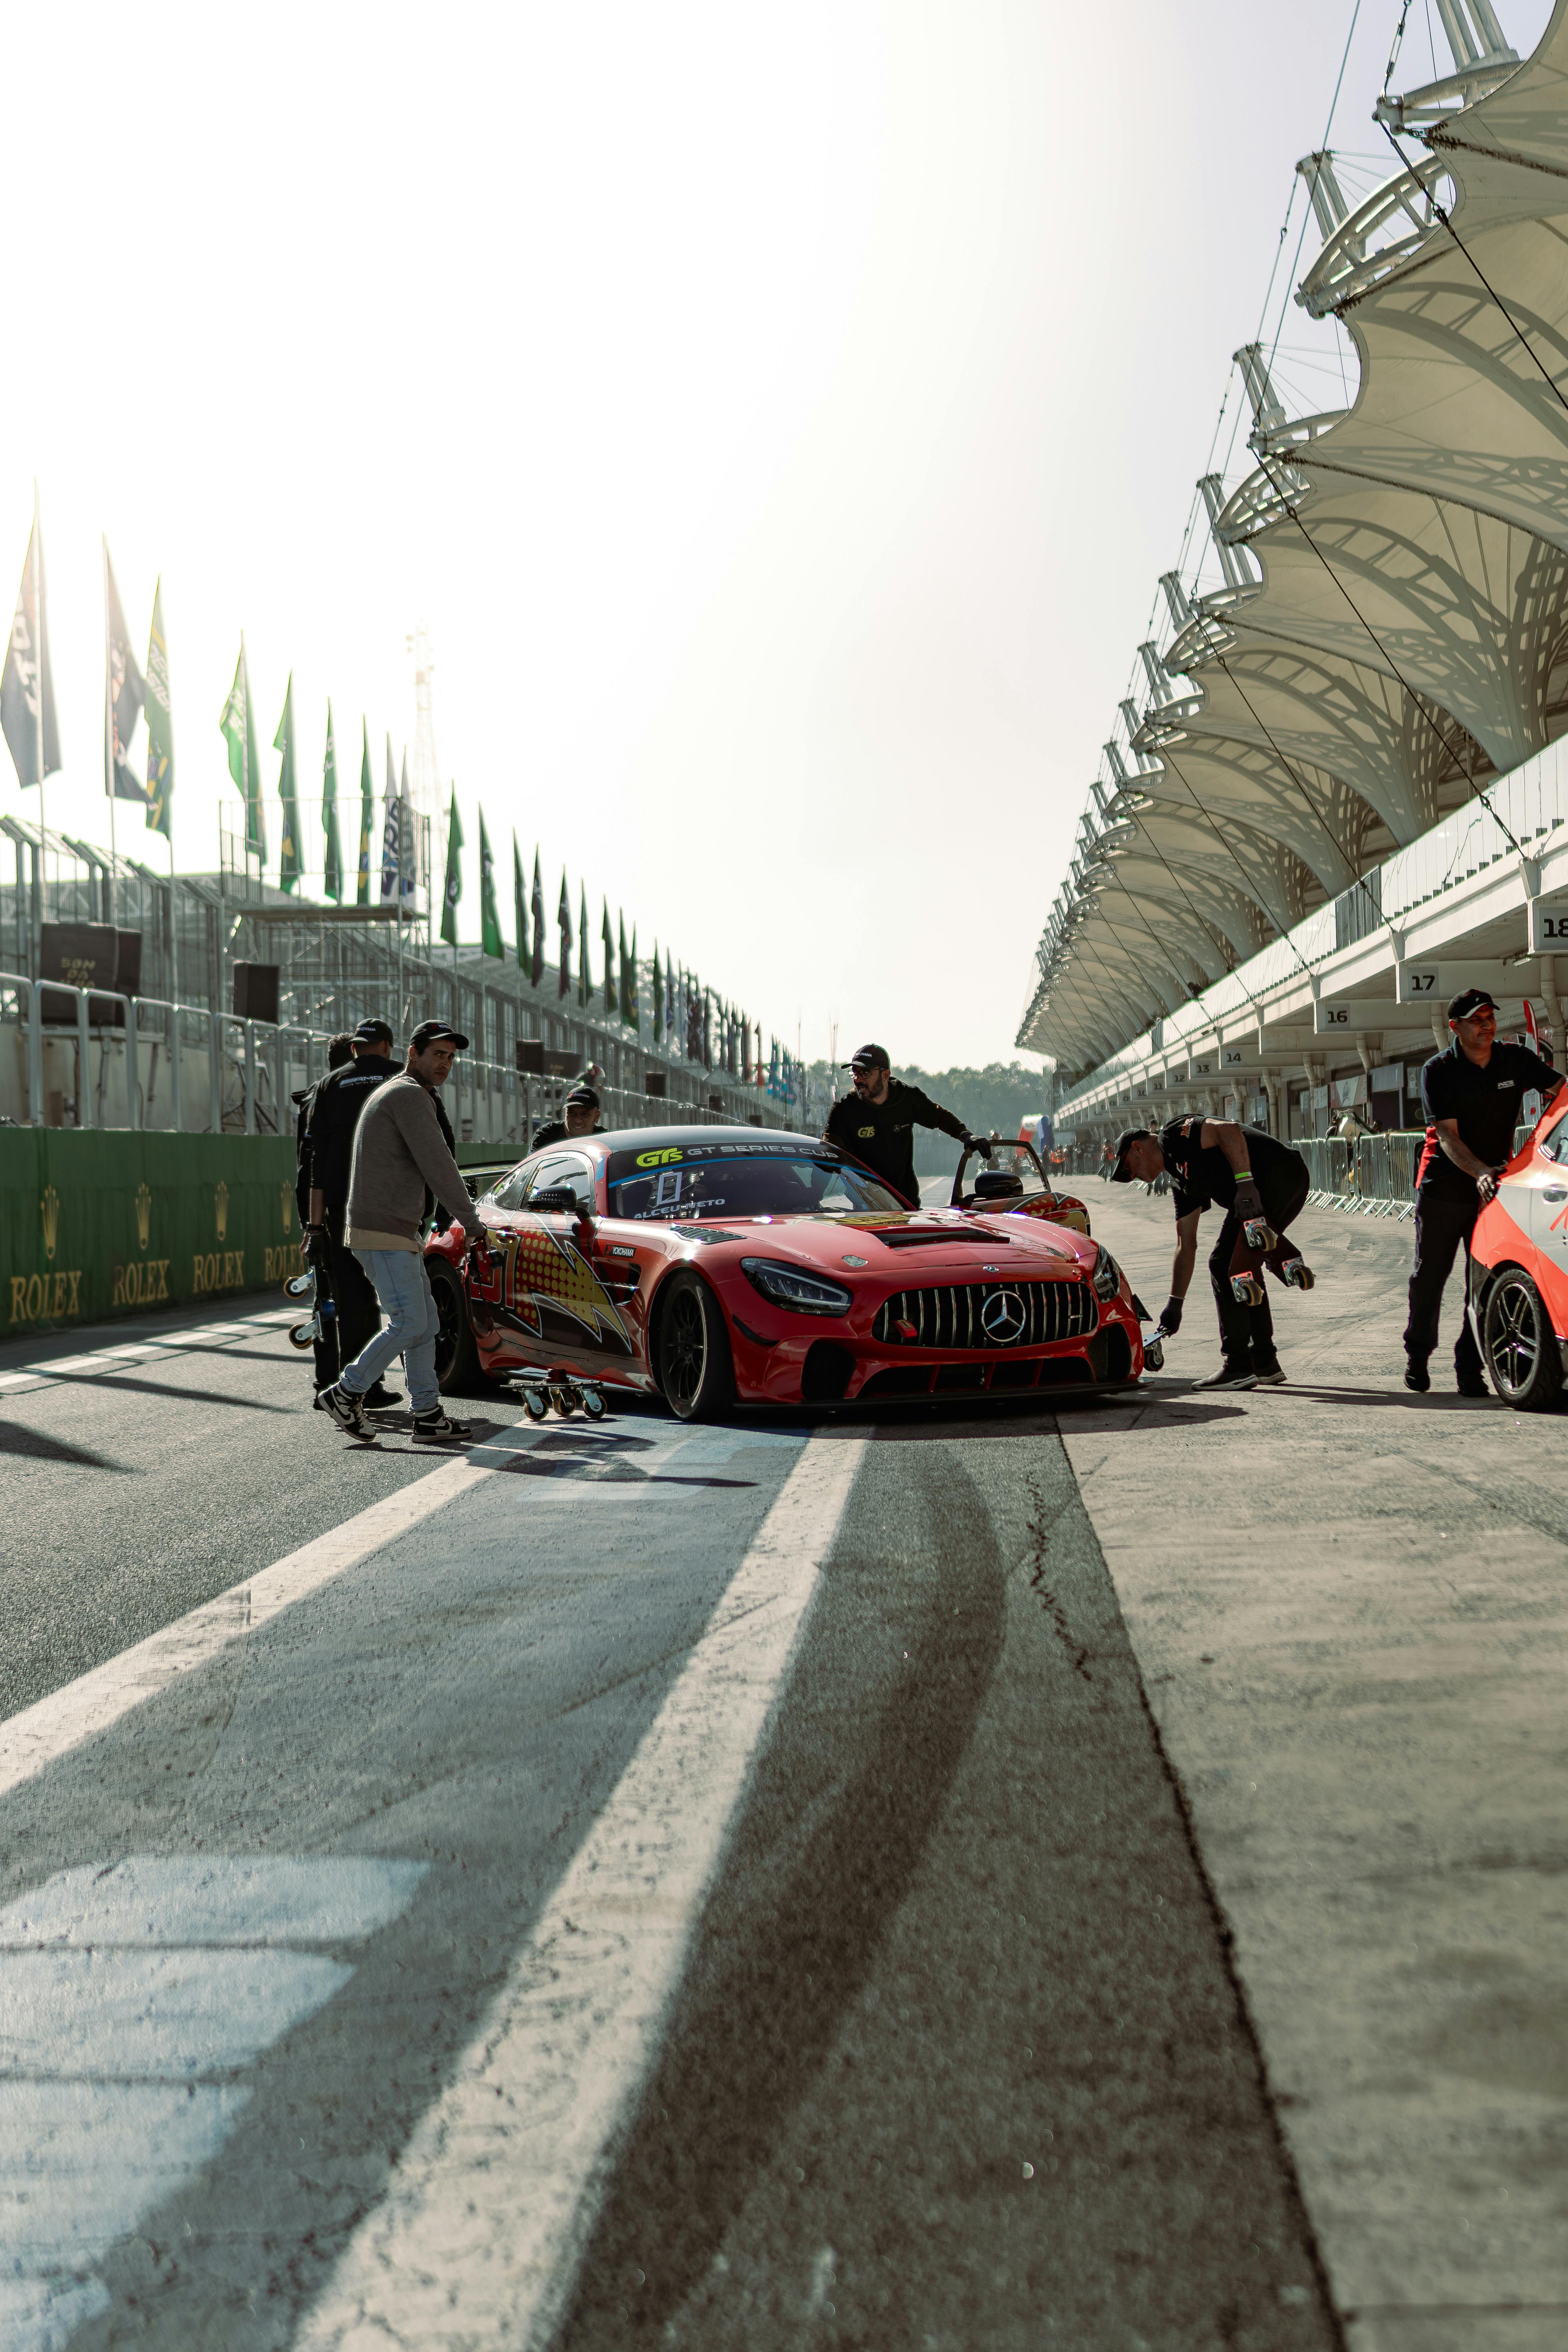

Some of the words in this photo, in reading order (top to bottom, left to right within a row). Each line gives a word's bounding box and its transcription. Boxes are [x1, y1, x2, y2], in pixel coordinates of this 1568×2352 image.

[1544, 918, 1568, 938] 18
[1412, 975, 1436, 991] 17
[1327, 1010, 1348, 1024] 16
[1226, 1053, 1242, 1062] 14
[1197, 1064, 1210, 1073] 13
[687, 1147, 716, 1156] GT
[799, 1148, 839, 1158] CUP
[634, 1205, 680, 1219] ALCEU
[685, 1199, 725, 1209] NETO
[613, 1246, 634, 1257] YOKOHAMA
[193, 1251, 245, 1294] ROLEX
[113, 1259, 170, 1306] ROLEX
[10, 1270, 82, 1324] ROLEX
